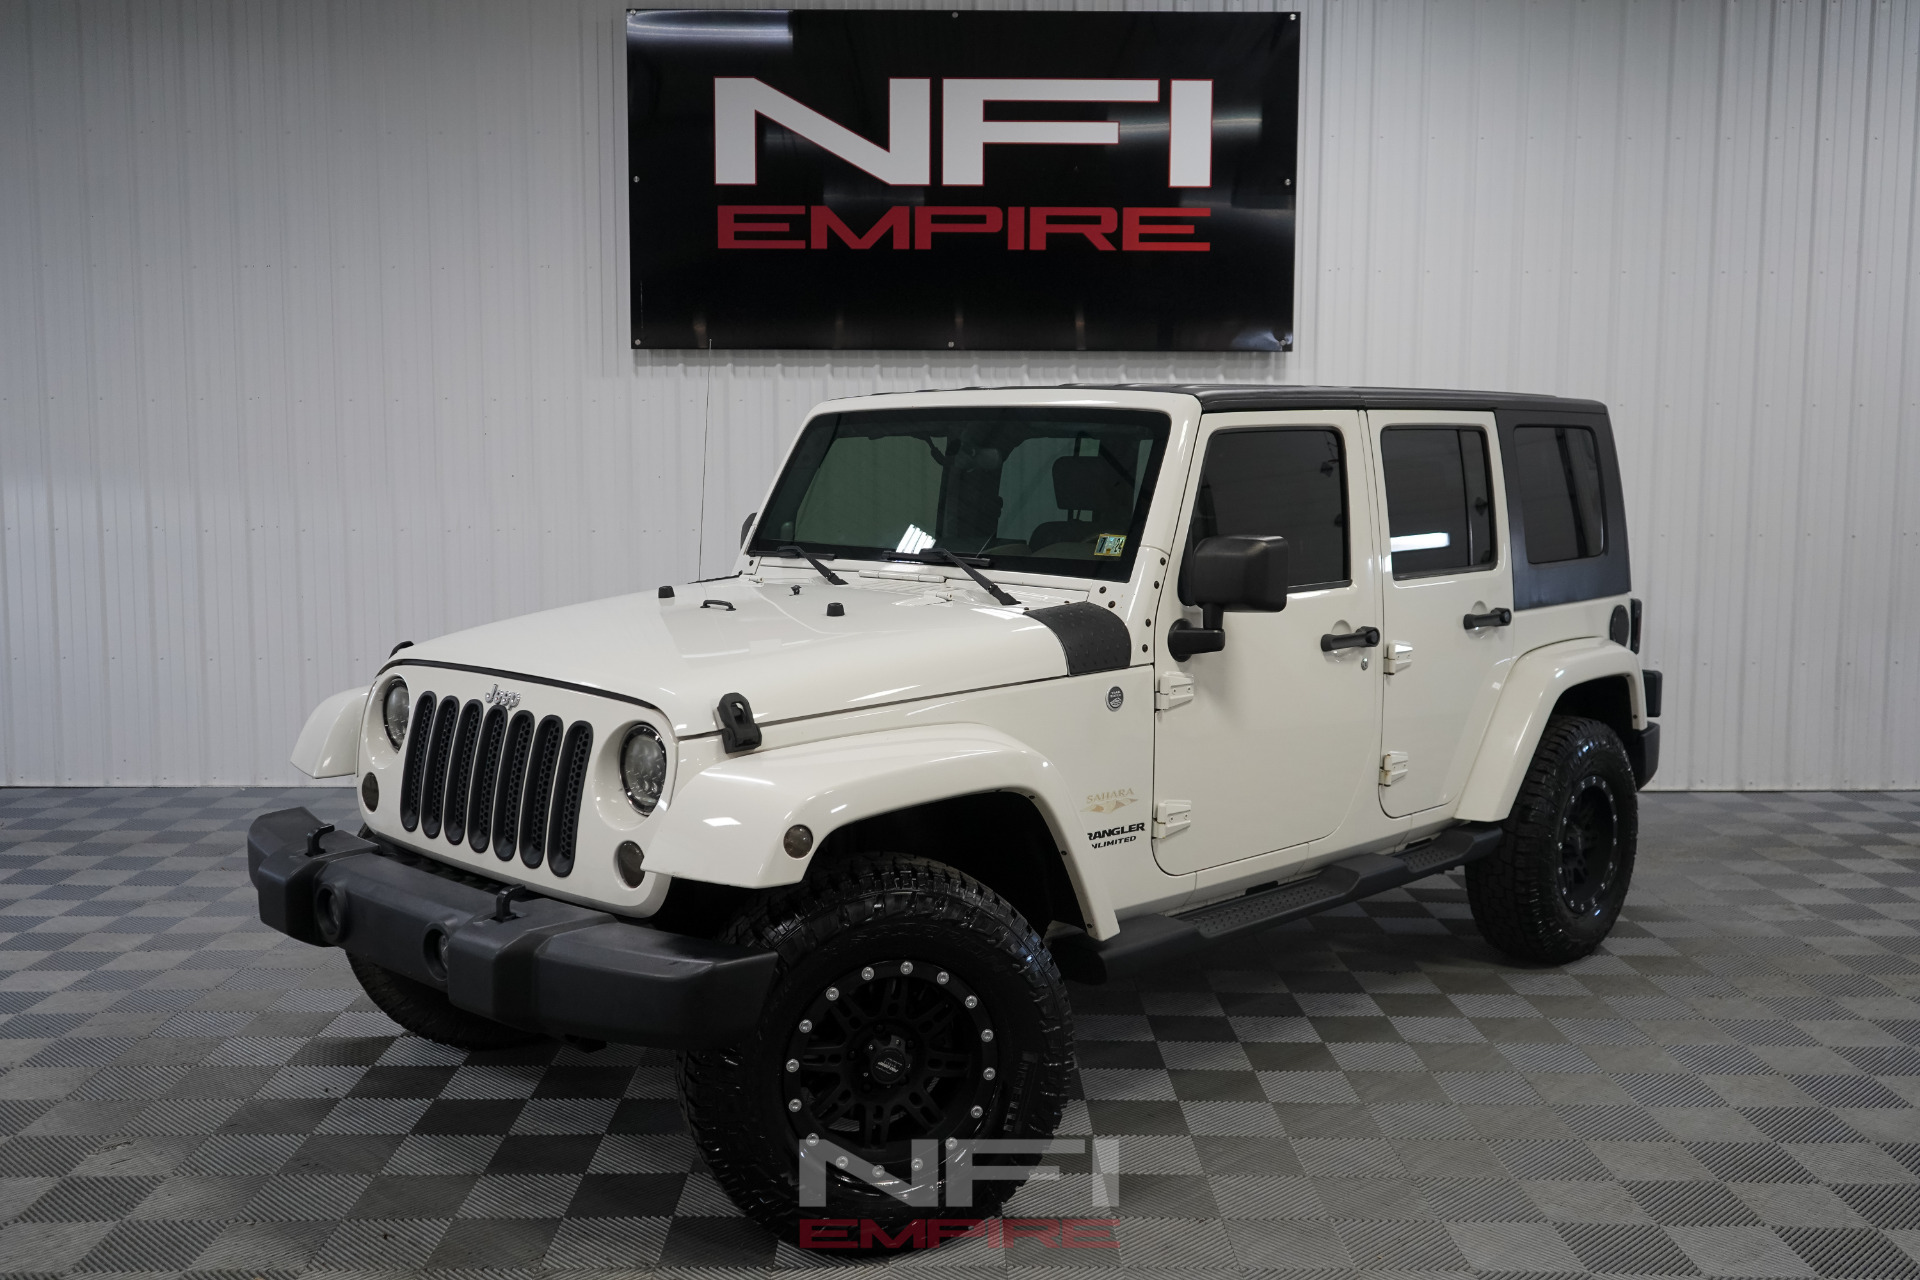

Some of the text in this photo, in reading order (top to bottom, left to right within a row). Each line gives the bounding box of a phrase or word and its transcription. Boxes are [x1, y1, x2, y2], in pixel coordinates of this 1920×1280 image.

[714, 77, 1213, 188] NFI
[717, 205, 1211, 251] EMPIRE
[485, 683, 521, 711] Jeep
[1086, 788, 1135, 804] SAHARA
[1087, 822, 1146, 841] RANGLER
[1091, 835, 1137, 850] NLIMITED
